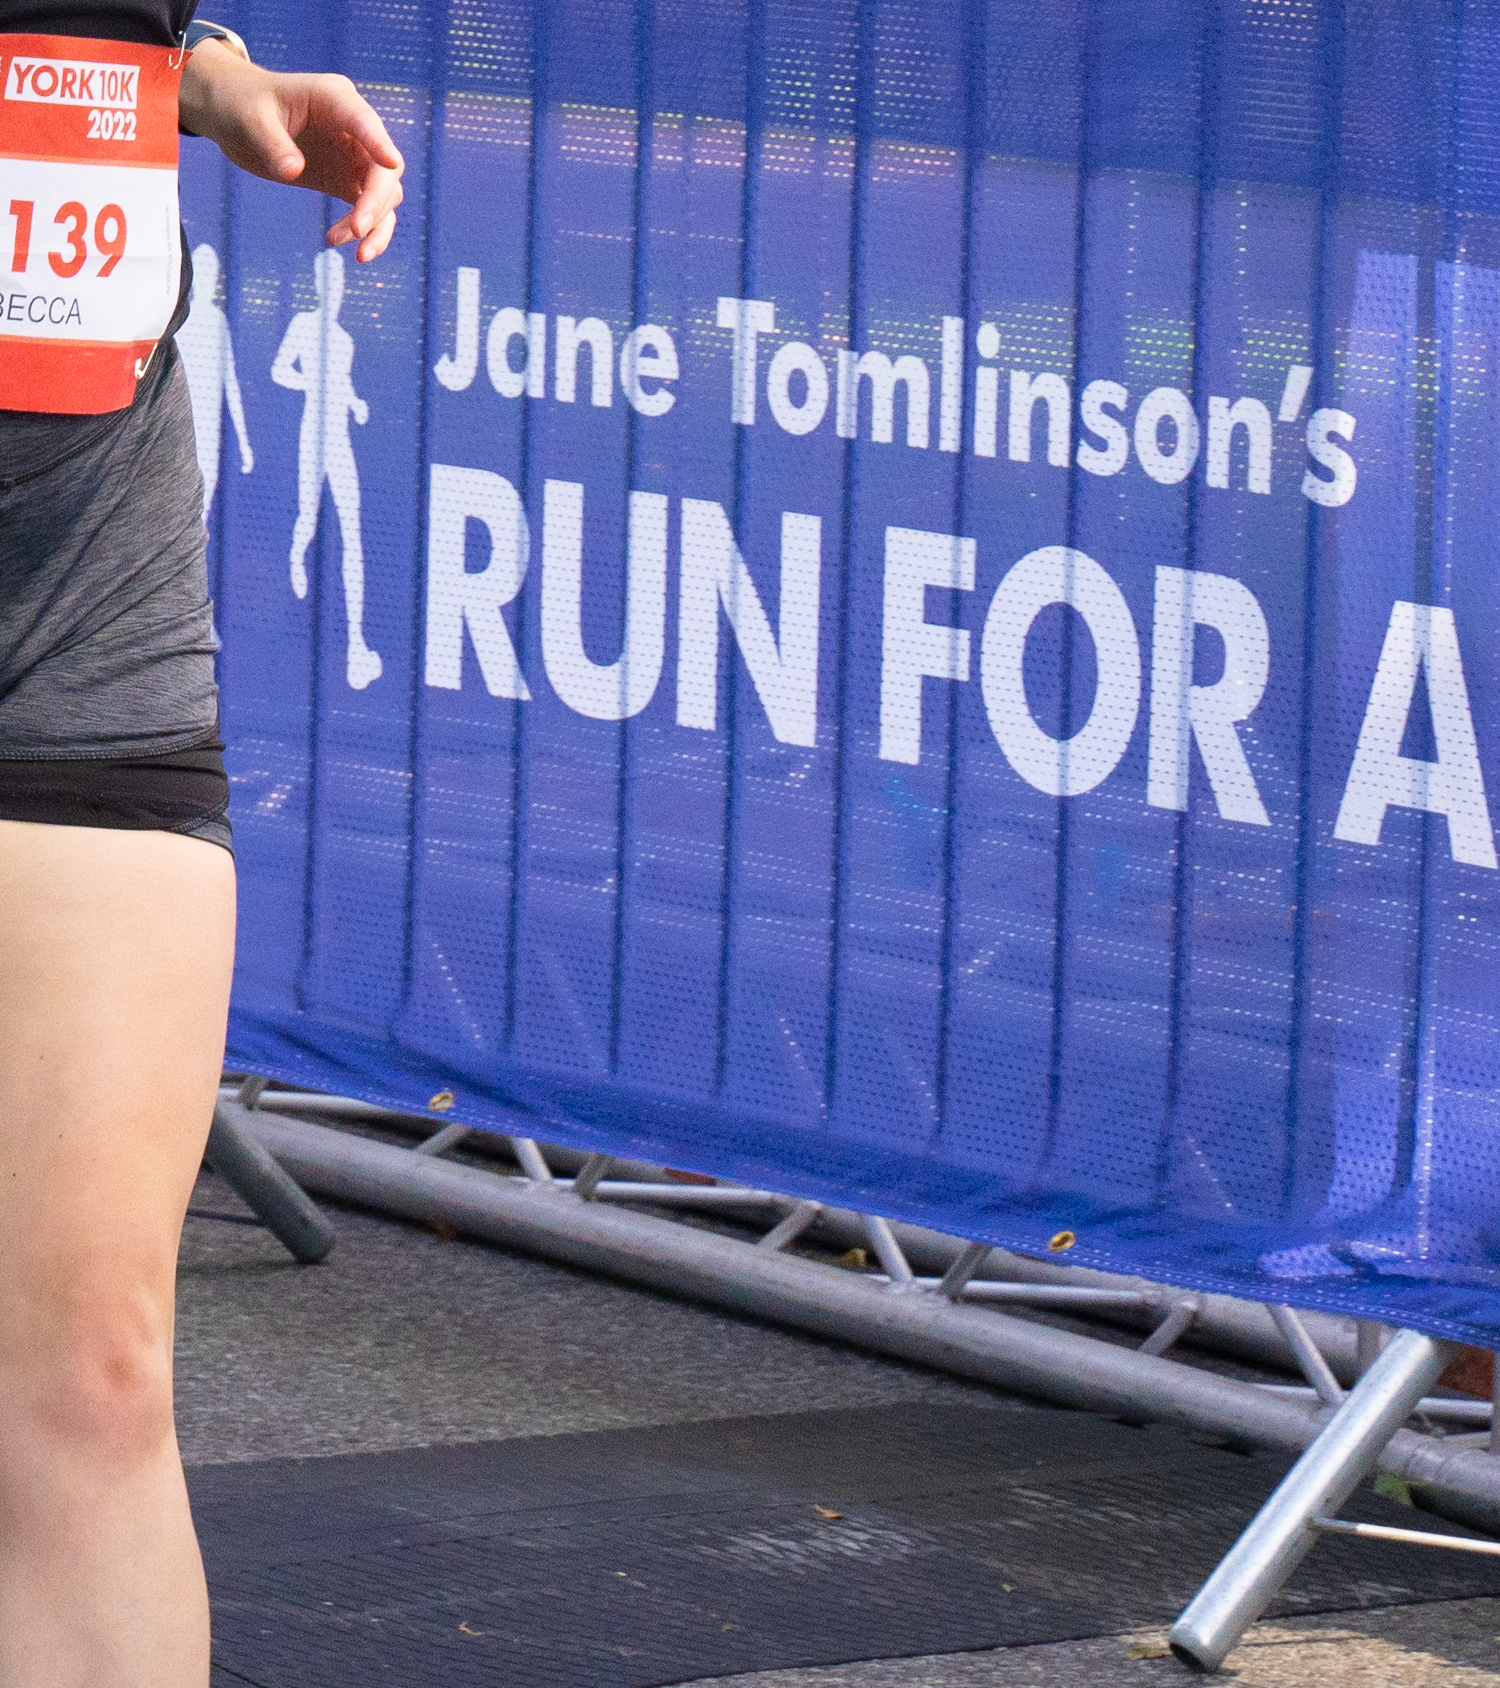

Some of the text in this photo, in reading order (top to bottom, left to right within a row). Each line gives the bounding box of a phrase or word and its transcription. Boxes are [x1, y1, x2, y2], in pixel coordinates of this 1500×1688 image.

[13, 63, 136, 103] YORK 10K
[86, 109, 137, 141] 2022
[433, 266, 1358, 508] Jane Tomlinson's
[424, 463, 822, 748] RUN
[879, 526, 1272, 827] FOR
